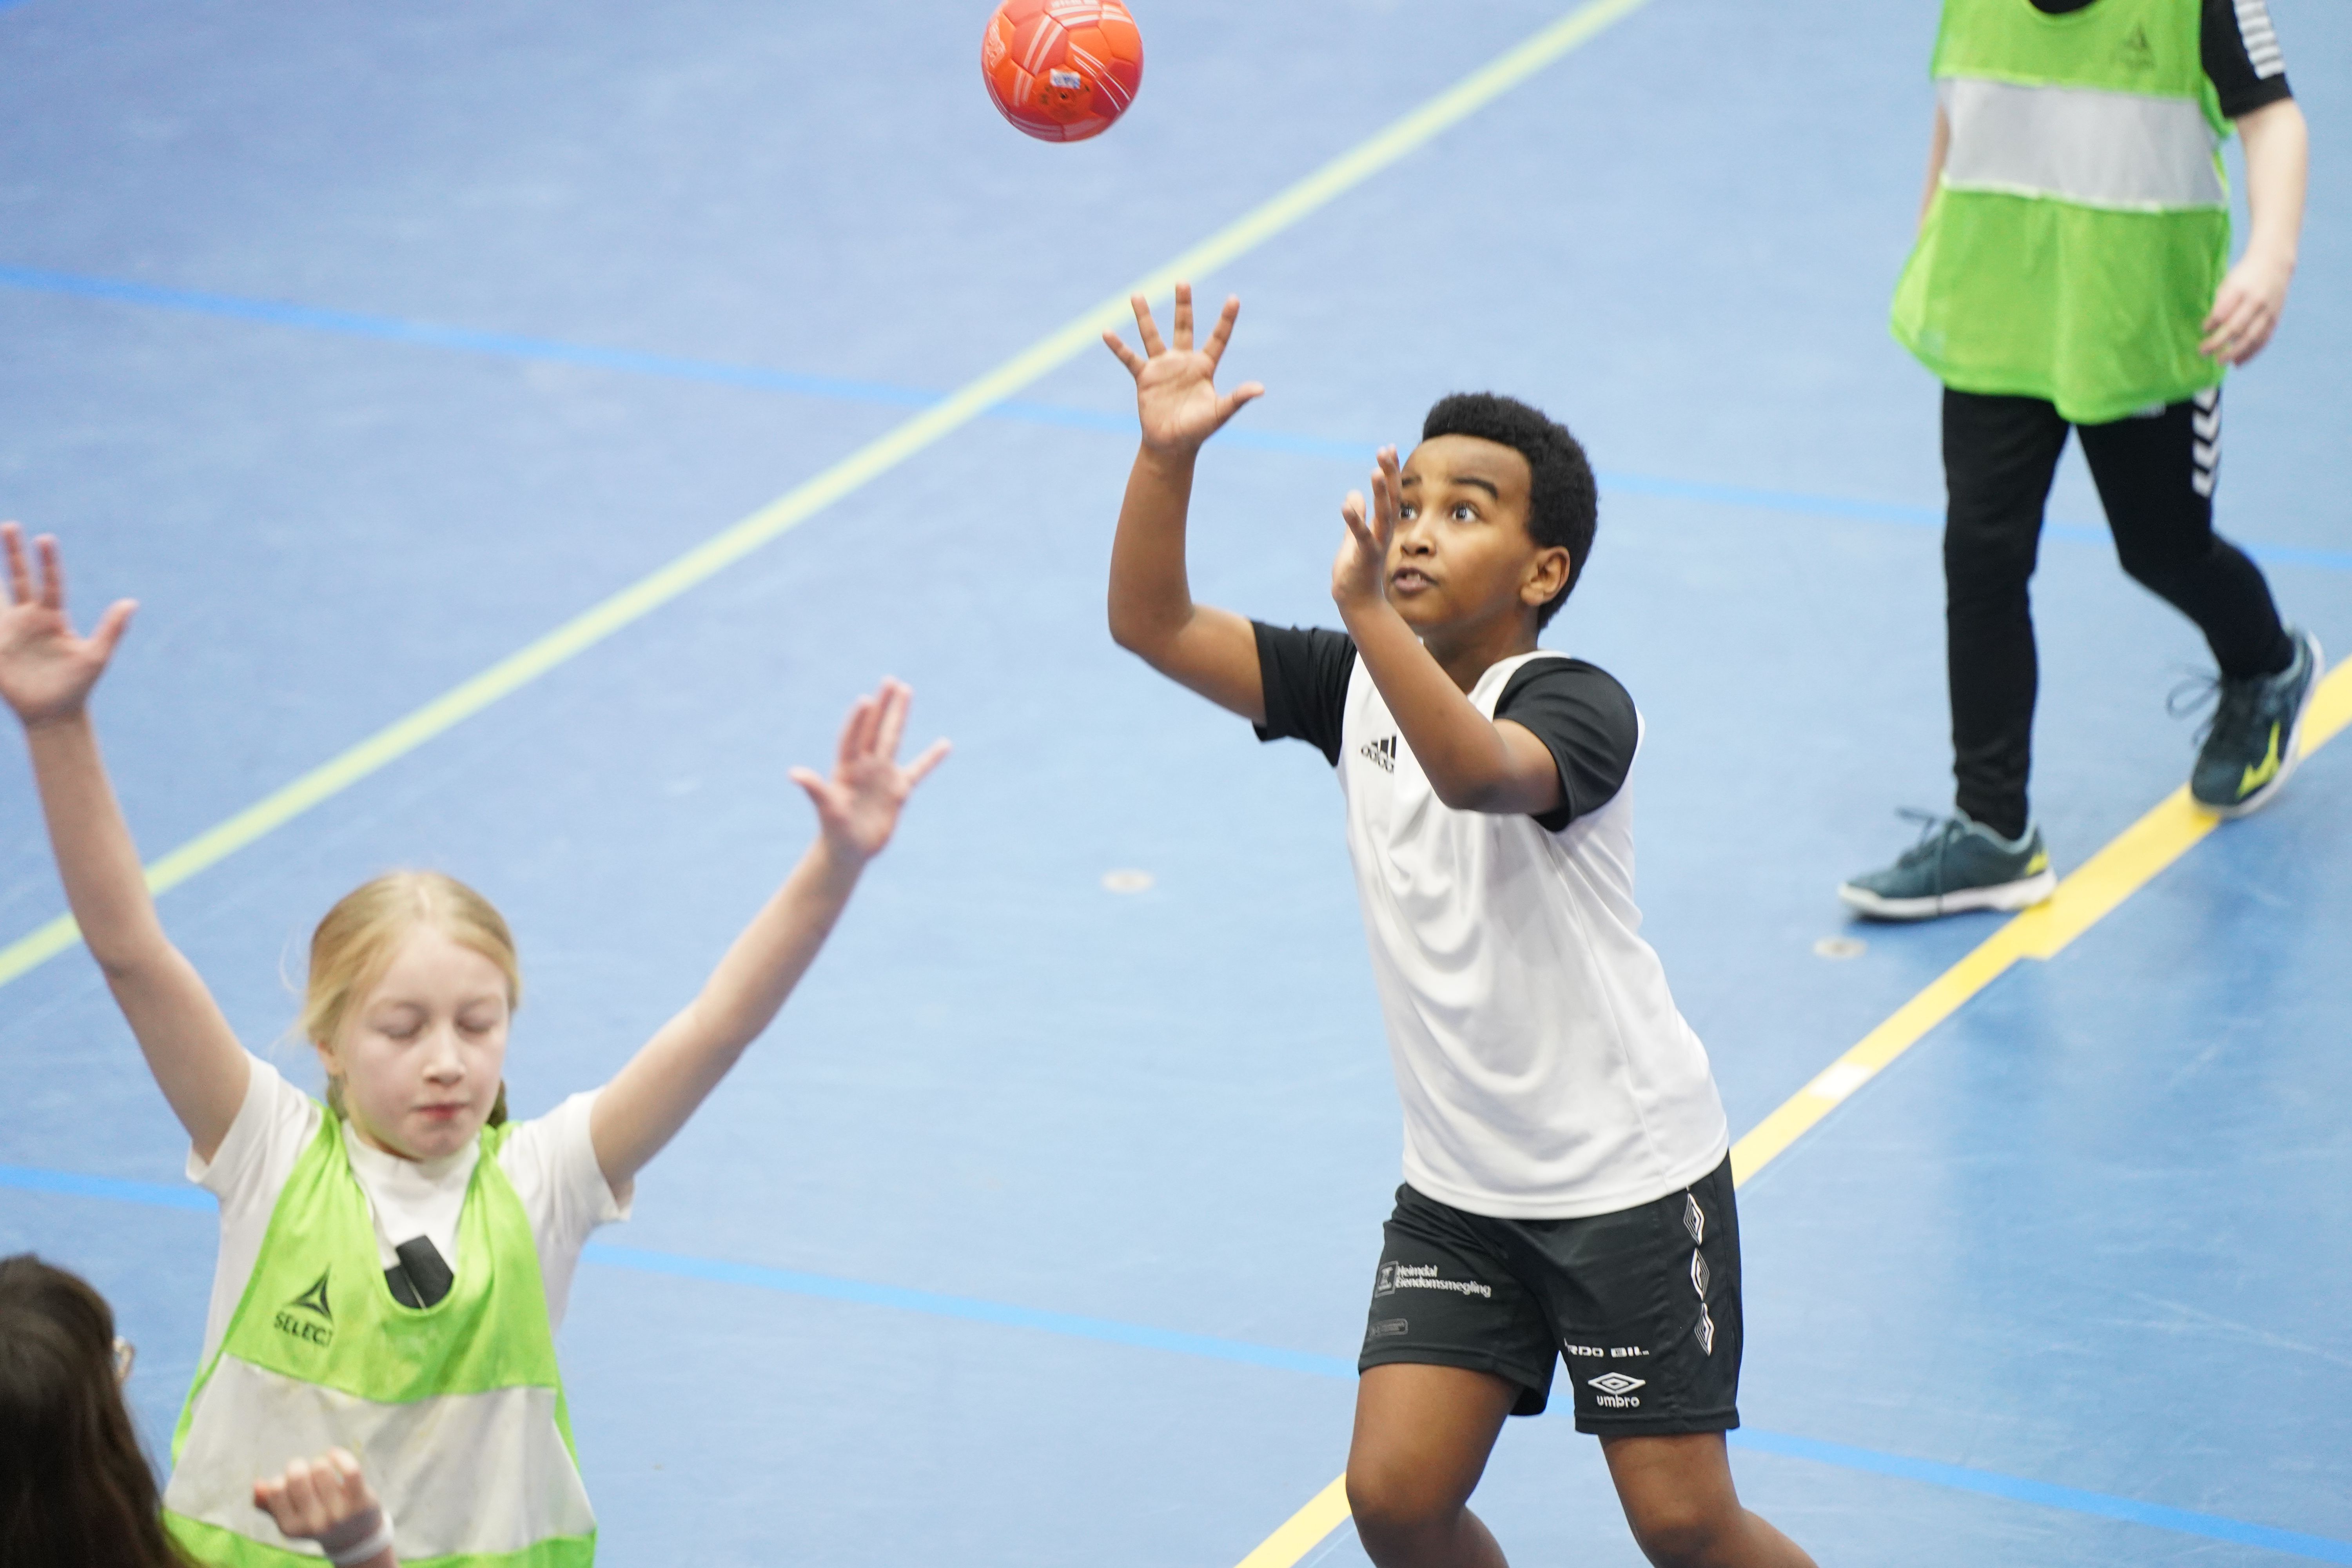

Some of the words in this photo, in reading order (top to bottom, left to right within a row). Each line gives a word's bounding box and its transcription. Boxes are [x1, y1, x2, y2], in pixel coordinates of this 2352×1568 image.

[1361, 745, 1395, 775] adida
[1564, 1338, 1604, 1357] RDO
[1597, 1394, 1640, 1408] umbro
